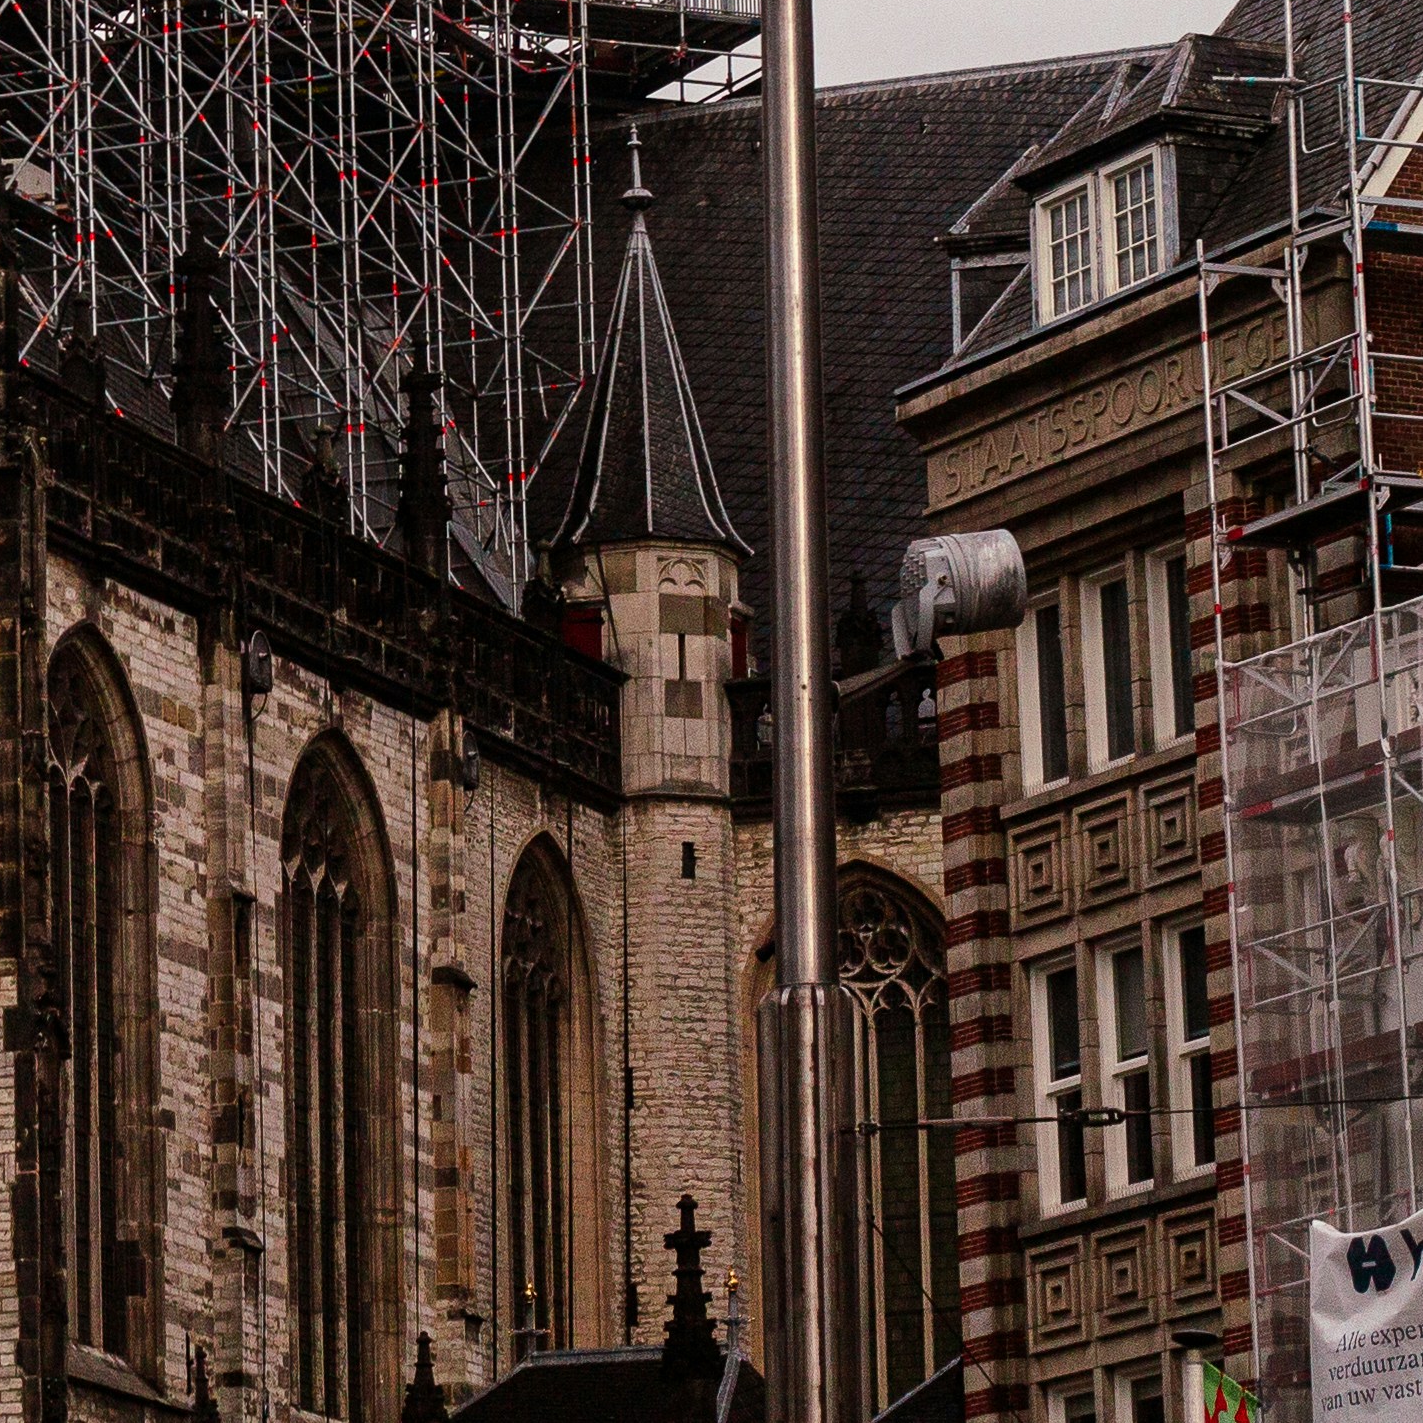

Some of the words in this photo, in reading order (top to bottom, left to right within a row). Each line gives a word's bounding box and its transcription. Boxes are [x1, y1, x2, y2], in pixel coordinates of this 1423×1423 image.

[1335, 1329, 1367, 1354] Alle
[1321, 1391, 1343, 1413] van
[1348, 1386, 1376, 1407] uw
[1381, 1379, 1423, 1401] vast
